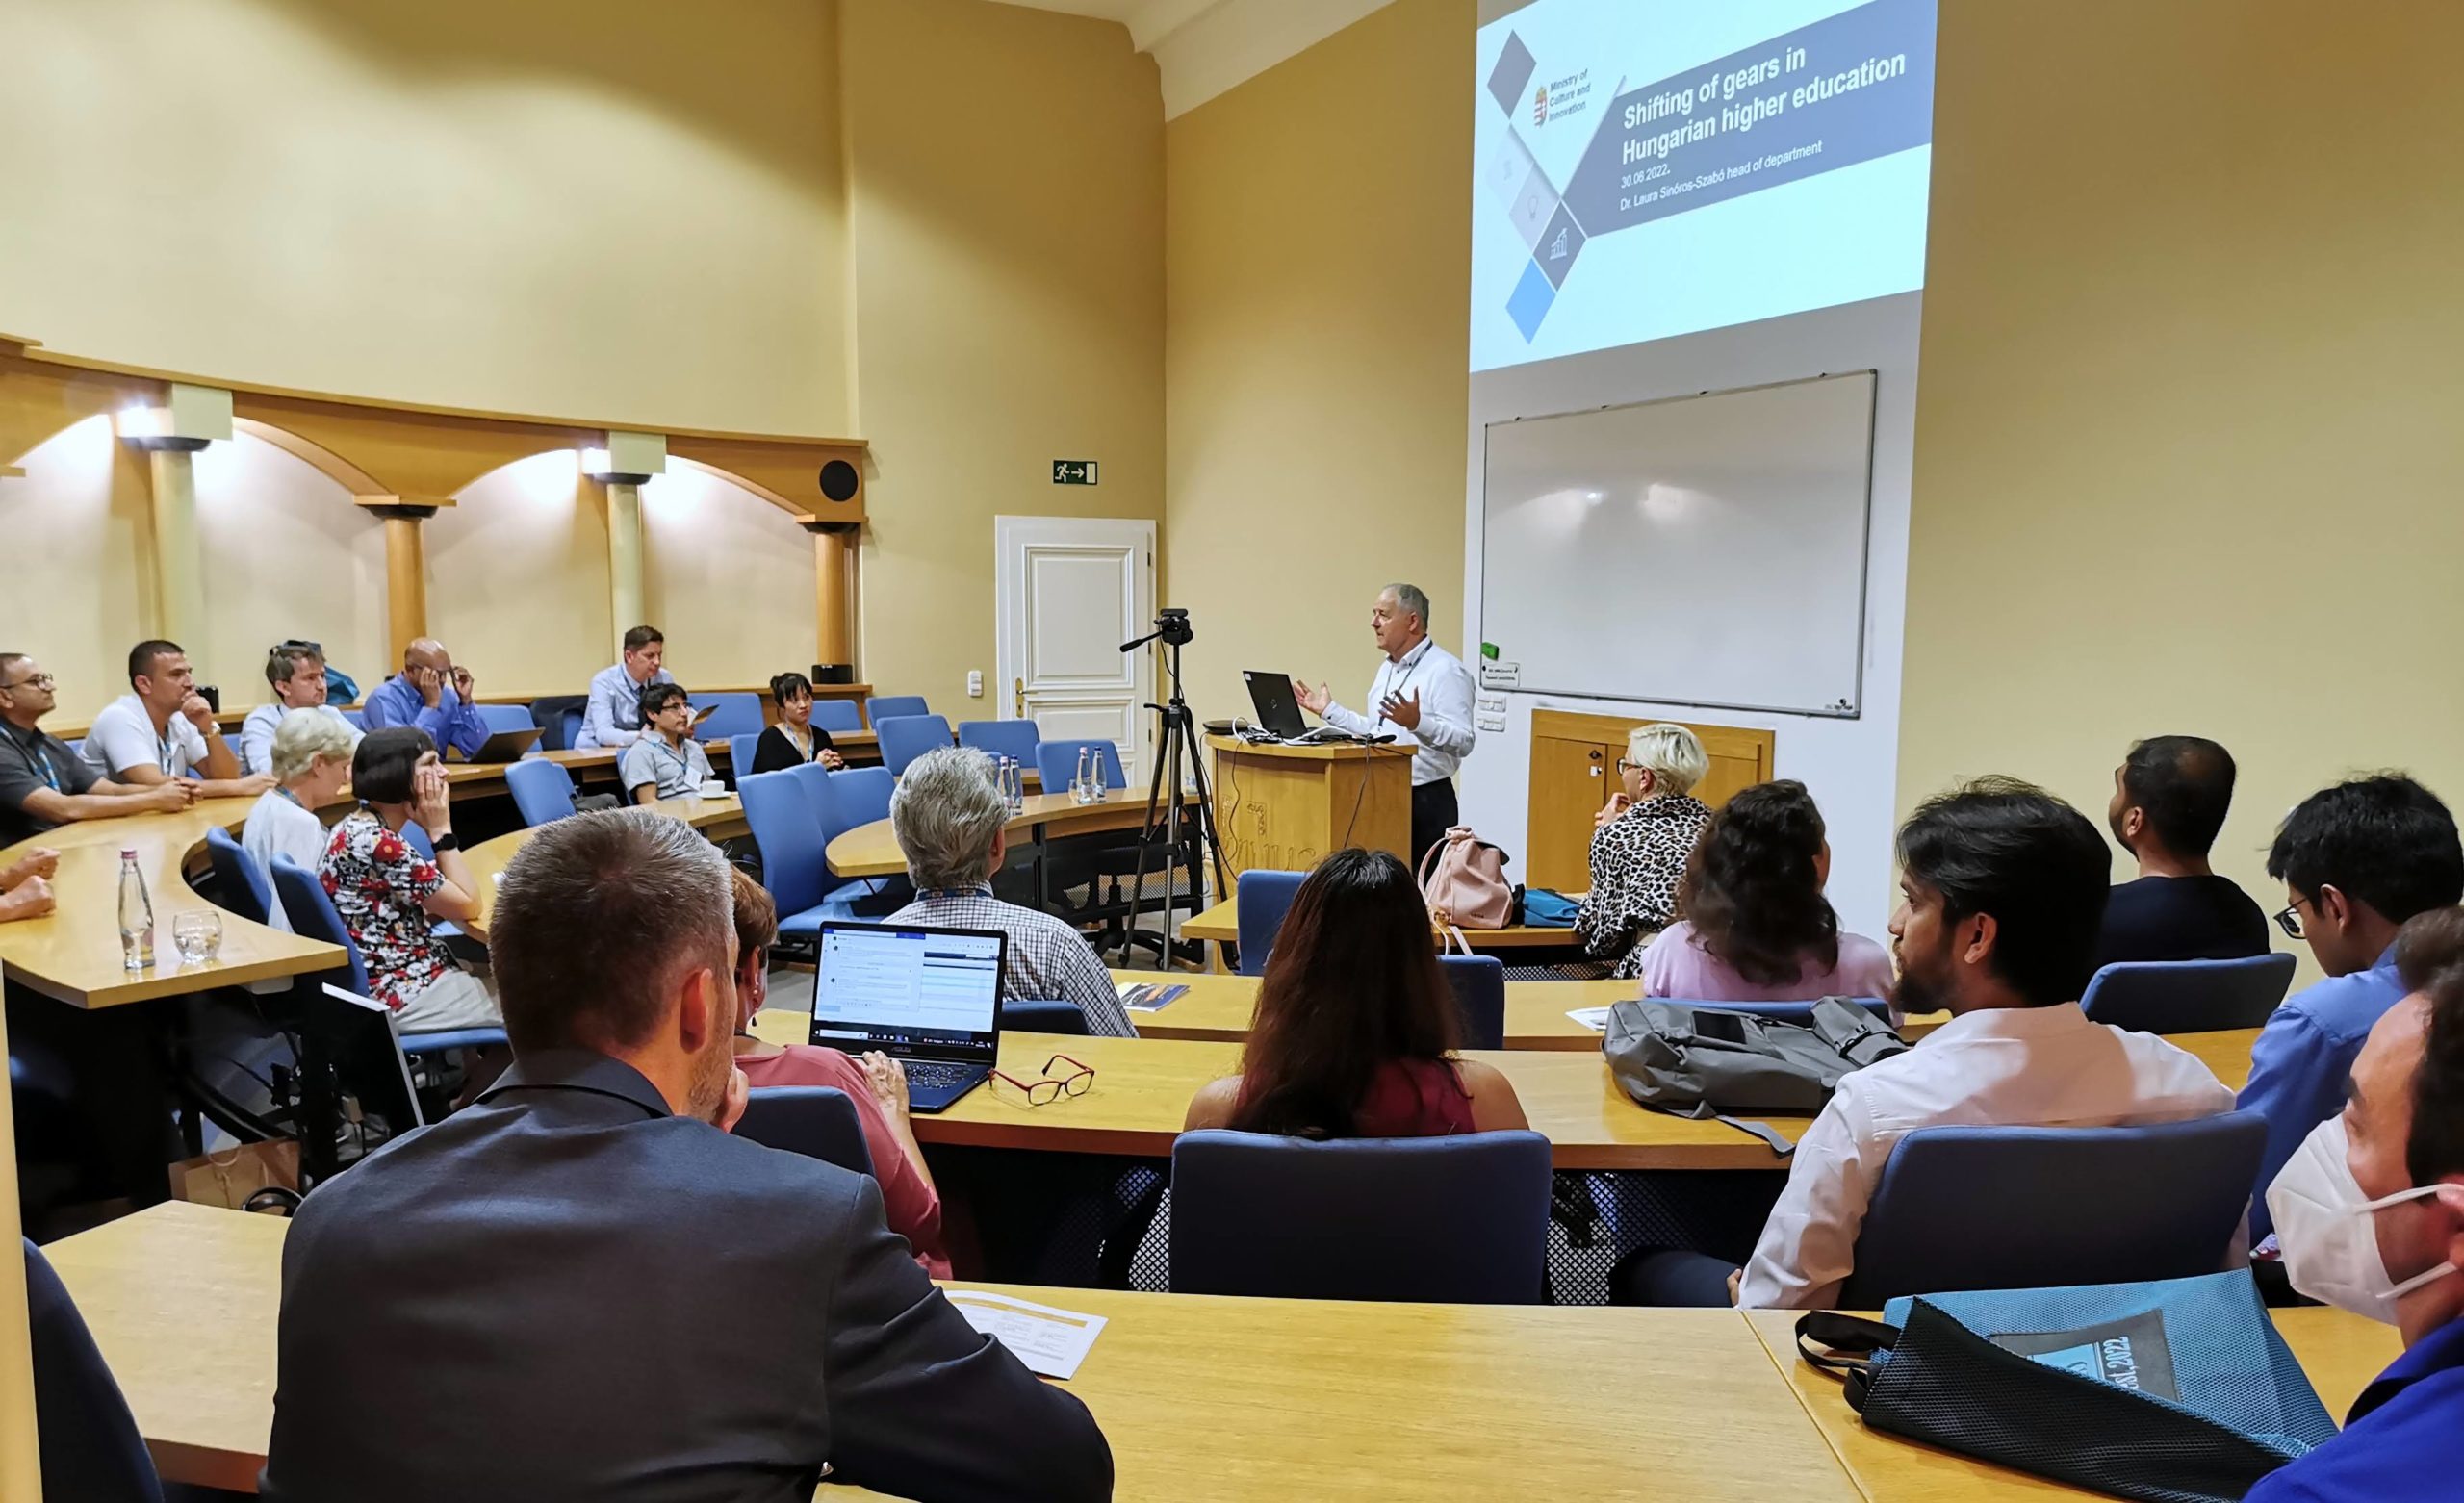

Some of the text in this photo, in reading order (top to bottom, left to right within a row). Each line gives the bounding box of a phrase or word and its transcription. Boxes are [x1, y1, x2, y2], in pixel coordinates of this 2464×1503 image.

[1550, 68, 1588, 92] Ministry of
[1577, 82, 1591, 96] and
[1622, 53, 1906, 165] Hungarian higher education
[1624, 46, 1806, 130] Shifting of gears in
[1620, 140, 1823, 211] Dr. Laura Sinóros-Szabó head of department
